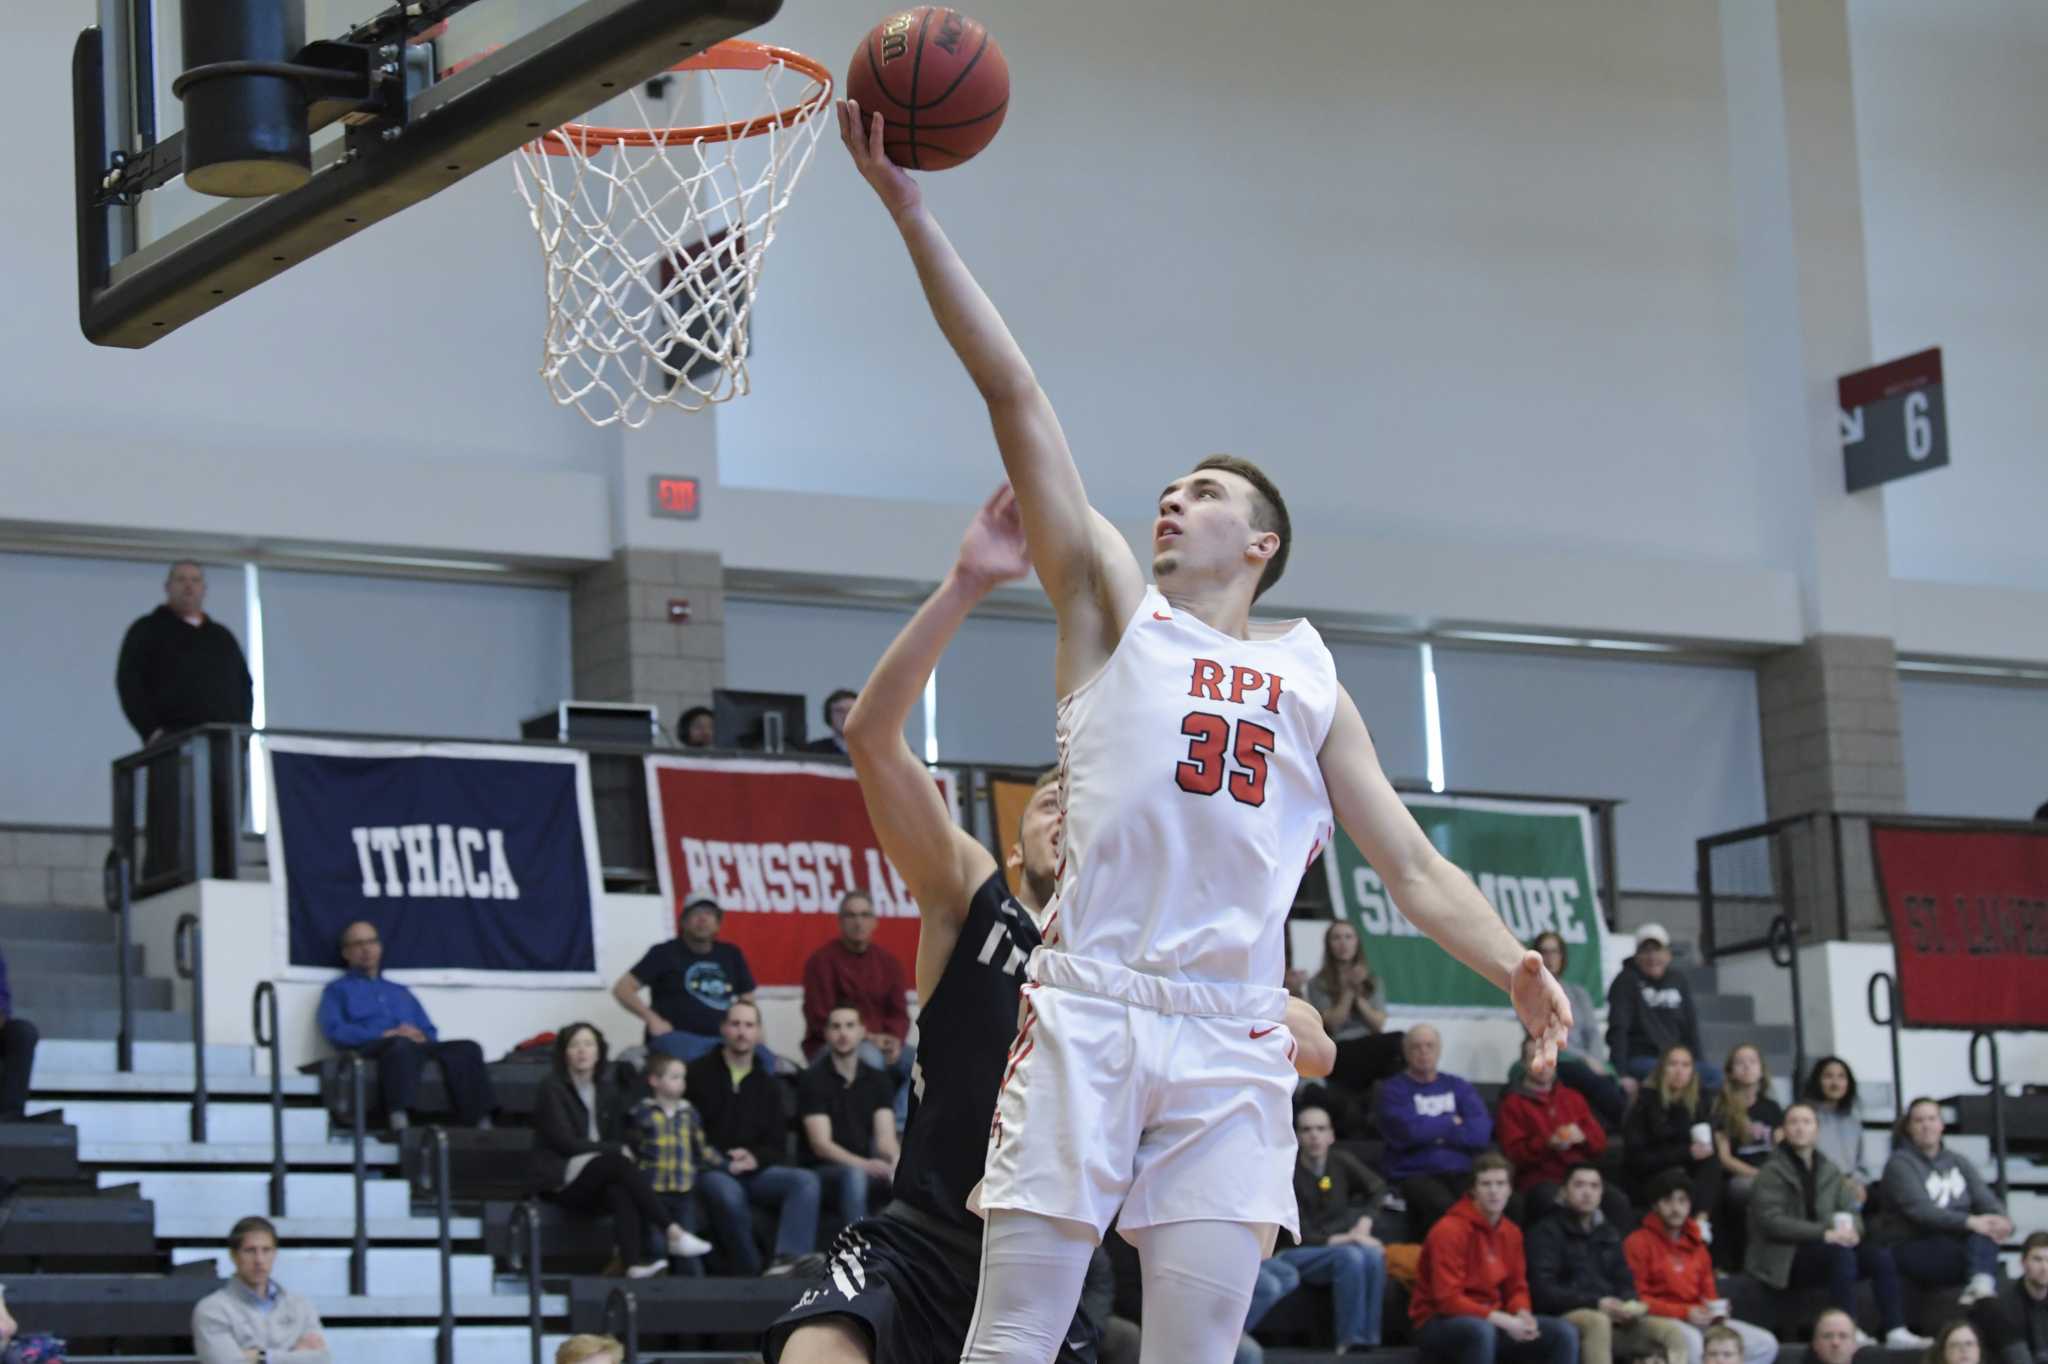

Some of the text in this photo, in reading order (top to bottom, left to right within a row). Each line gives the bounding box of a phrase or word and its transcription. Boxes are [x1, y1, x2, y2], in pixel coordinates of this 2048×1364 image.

[1904, 391, 1933, 461] 6
[1187, 657, 1284, 714] RPI
[1175, 710, 1275, 808] 35
[352, 823, 520, 900] ITHACA
